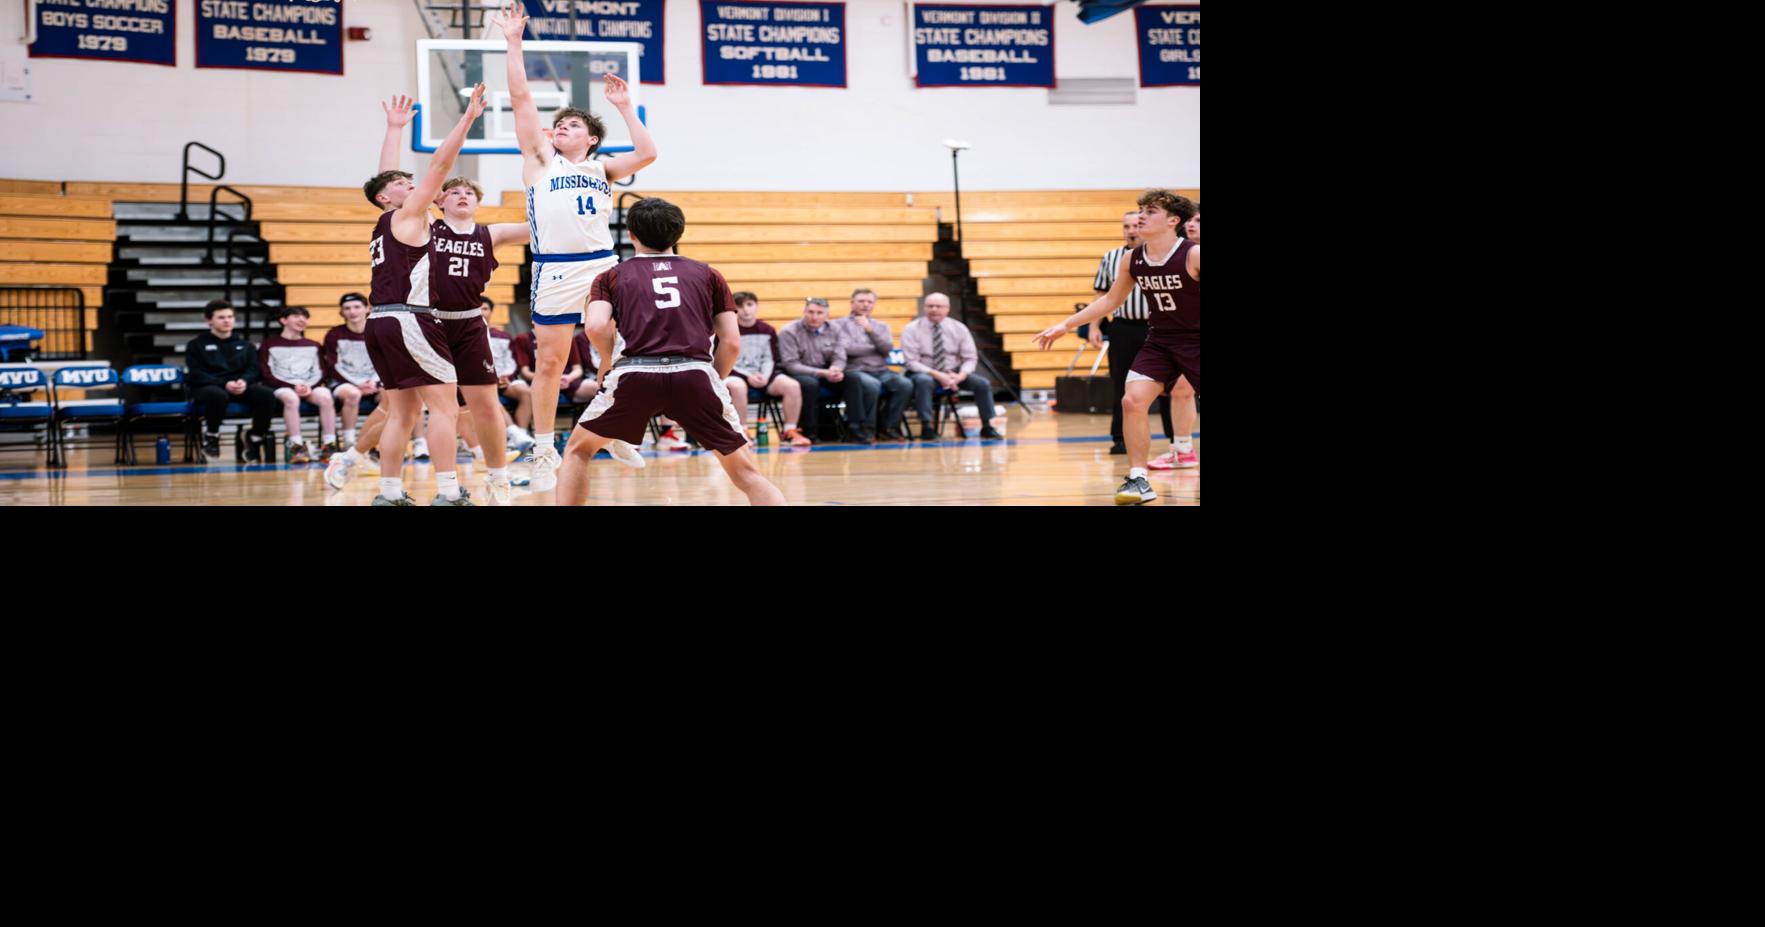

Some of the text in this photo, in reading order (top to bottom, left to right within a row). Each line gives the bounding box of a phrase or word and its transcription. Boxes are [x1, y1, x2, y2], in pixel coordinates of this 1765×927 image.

[201, 1, 337, 25] STATE CHAMPIONS
[541, 0, 641, 15] VERMONT
[717, 6, 769, 21] VERMONT
[41, 11, 163, 34] BOYS SOCCER
[921, 10, 975, 24] VERMONT
[212, 24, 327, 45] BASEBALL
[598, 19, 653, 38] CHAMPIONS
[707, 23, 841, 45] STATE CHAMPIONS
[915, 27, 1049, 46] STATE CHAMPIONS
[1147, 28, 1184, 45] STATE
[77, 34, 128, 51] 1979
[245, 46, 297, 63] 1979
[719, 45, 831, 62] SOFTBALL
[927, 48, 1039, 64] BASEBALL
[576, 195, 597, 215] 14
[435, 237, 485, 257] EAGLES
[448, 256, 470, 278] 21
[1136, 274, 1183, 291] EAGLES
[651, 276, 681, 309] 5
[1153, 292, 1177, 312] 13
[61, 368, 110, 384] MVU
[129, 367, 177, 383] MVU
